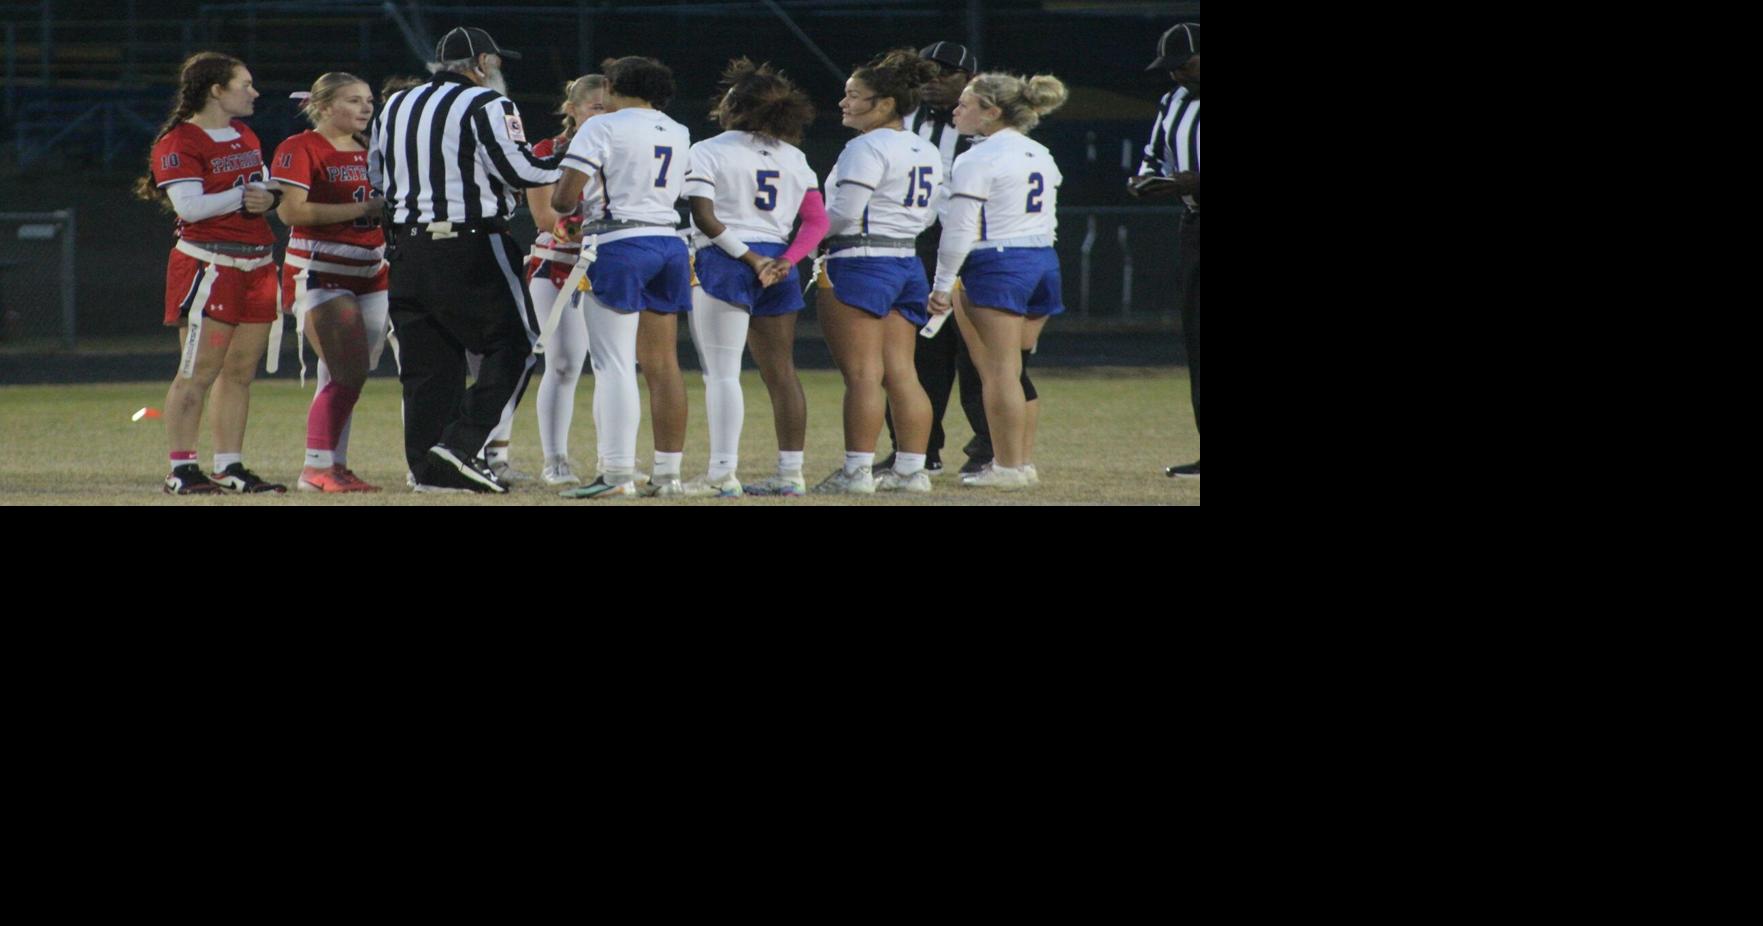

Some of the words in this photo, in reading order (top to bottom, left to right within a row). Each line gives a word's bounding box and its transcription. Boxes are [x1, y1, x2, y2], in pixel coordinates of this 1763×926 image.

[161, 152, 181, 171] 10
[653, 144, 673, 188] 7
[754, 168, 780, 212] 5
[903, 165, 934, 208] 15
[1025, 171, 1045, 214] 2
